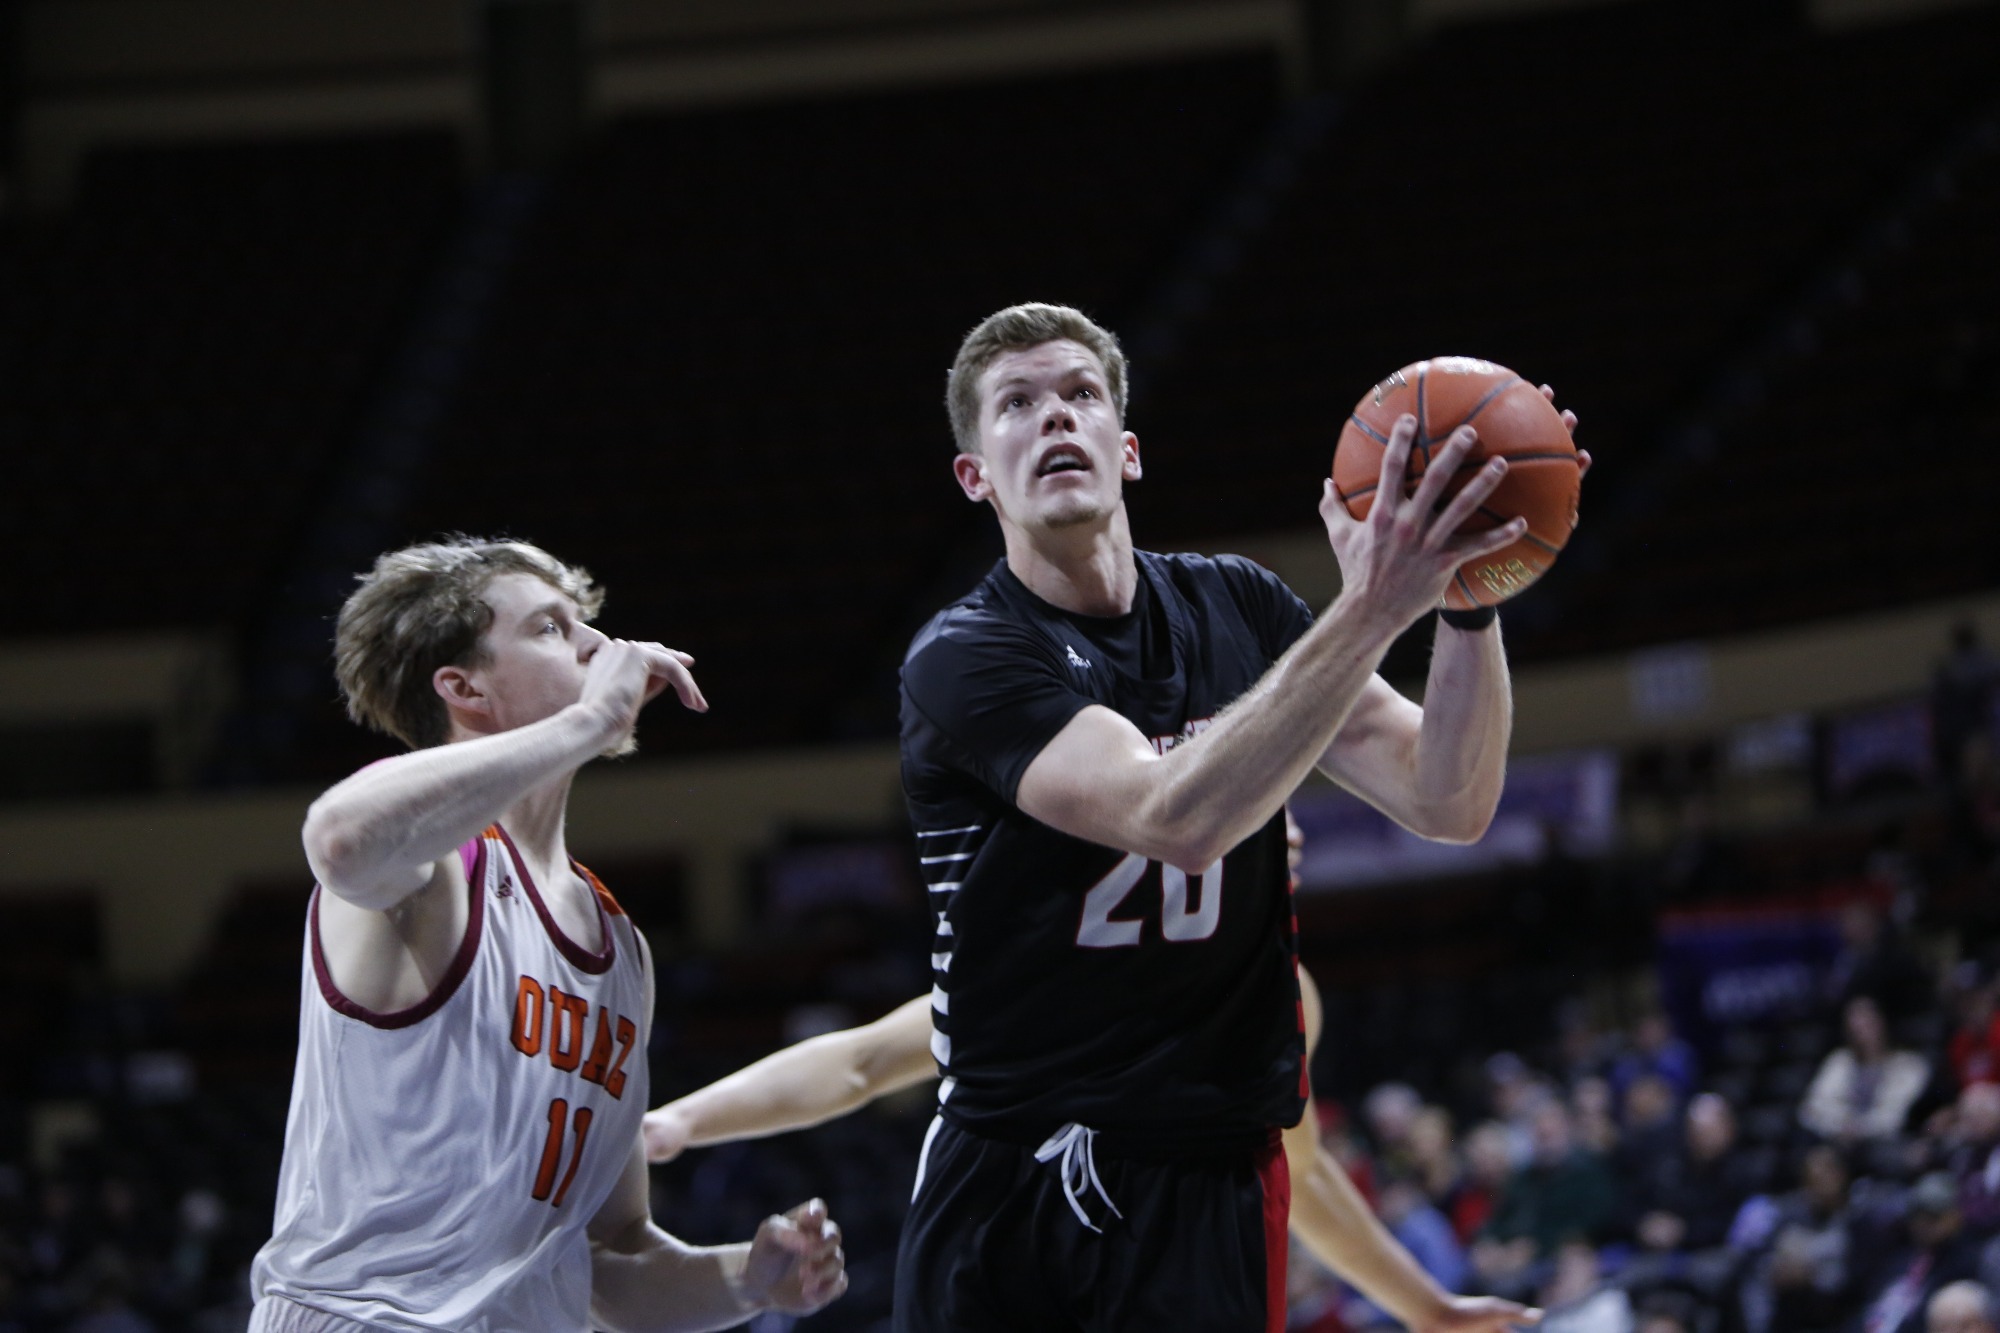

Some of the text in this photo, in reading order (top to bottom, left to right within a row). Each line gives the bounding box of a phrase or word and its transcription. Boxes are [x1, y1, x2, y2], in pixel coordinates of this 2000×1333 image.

[1074, 852, 1224, 950] 20
[510, 975, 636, 1100] OUAZ
[531, 1098, 593, 1208] 11
